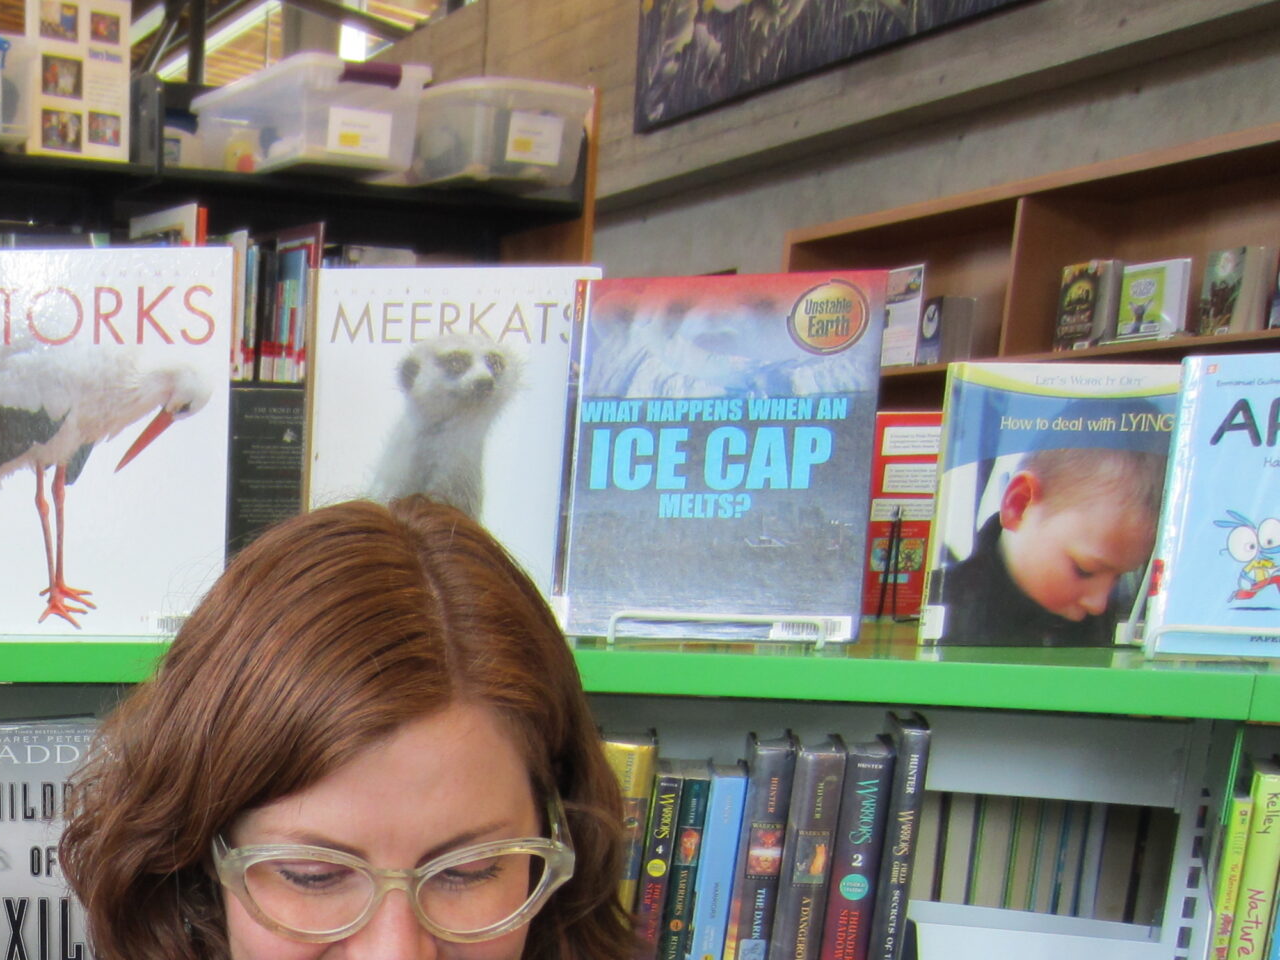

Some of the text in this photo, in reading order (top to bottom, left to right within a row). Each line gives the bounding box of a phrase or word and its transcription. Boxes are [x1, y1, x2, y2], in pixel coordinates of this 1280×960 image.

[804, 297, 851, 315] Unstable
[808, 316, 849, 338] Earth
[582, 398, 848, 423] WHAT HAPPENS WHEN AN
[1000, 413, 1176, 432] How to deal with LYING
[589, 428, 689, 490] ICE
[703, 426, 832, 490] CAP
[658, 494, 751, 518] MELTS?
[903, 752, 921, 795] HUNTER
[654, 793, 676, 839] WARRIORS
[767, 777, 779, 814] HUNTER
[848, 779, 880, 868] WARRIORS 2
[892, 810, 915, 856] WARRIORS
[29, 846, 58, 877] OF
[673, 869, 688, 916] WARRIORS
[833, 908, 849, 960] SHADOW
[1237, 888, 1266, 957] Nature
